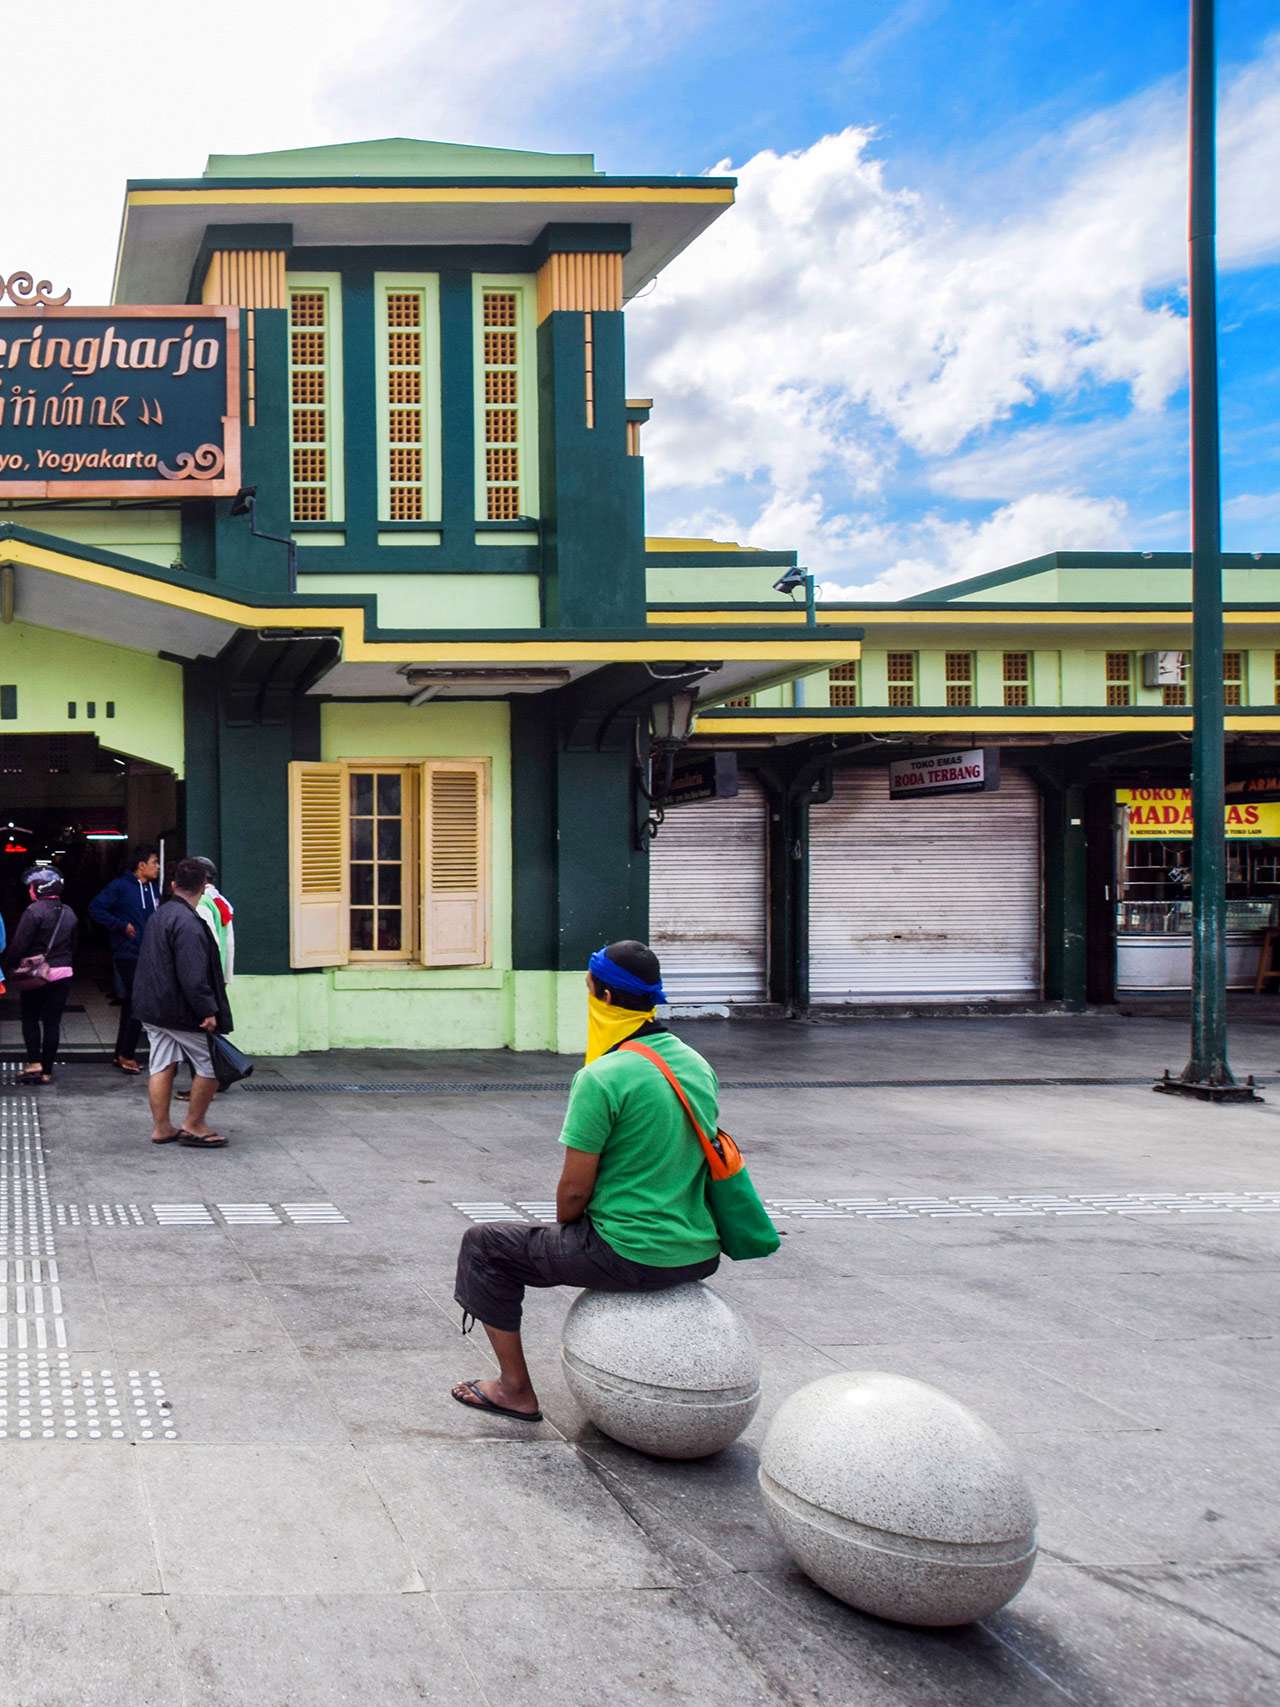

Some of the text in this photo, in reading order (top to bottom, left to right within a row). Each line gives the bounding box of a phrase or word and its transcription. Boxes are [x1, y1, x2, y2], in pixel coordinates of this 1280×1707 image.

[36, 449, 157, 472] Yogyakarta
[911, 756, 963, 770] TOKO EMAS
[894, 764, 981, 787] RODA TERBANG
[1129, 787, 1176, 801] TOKO
